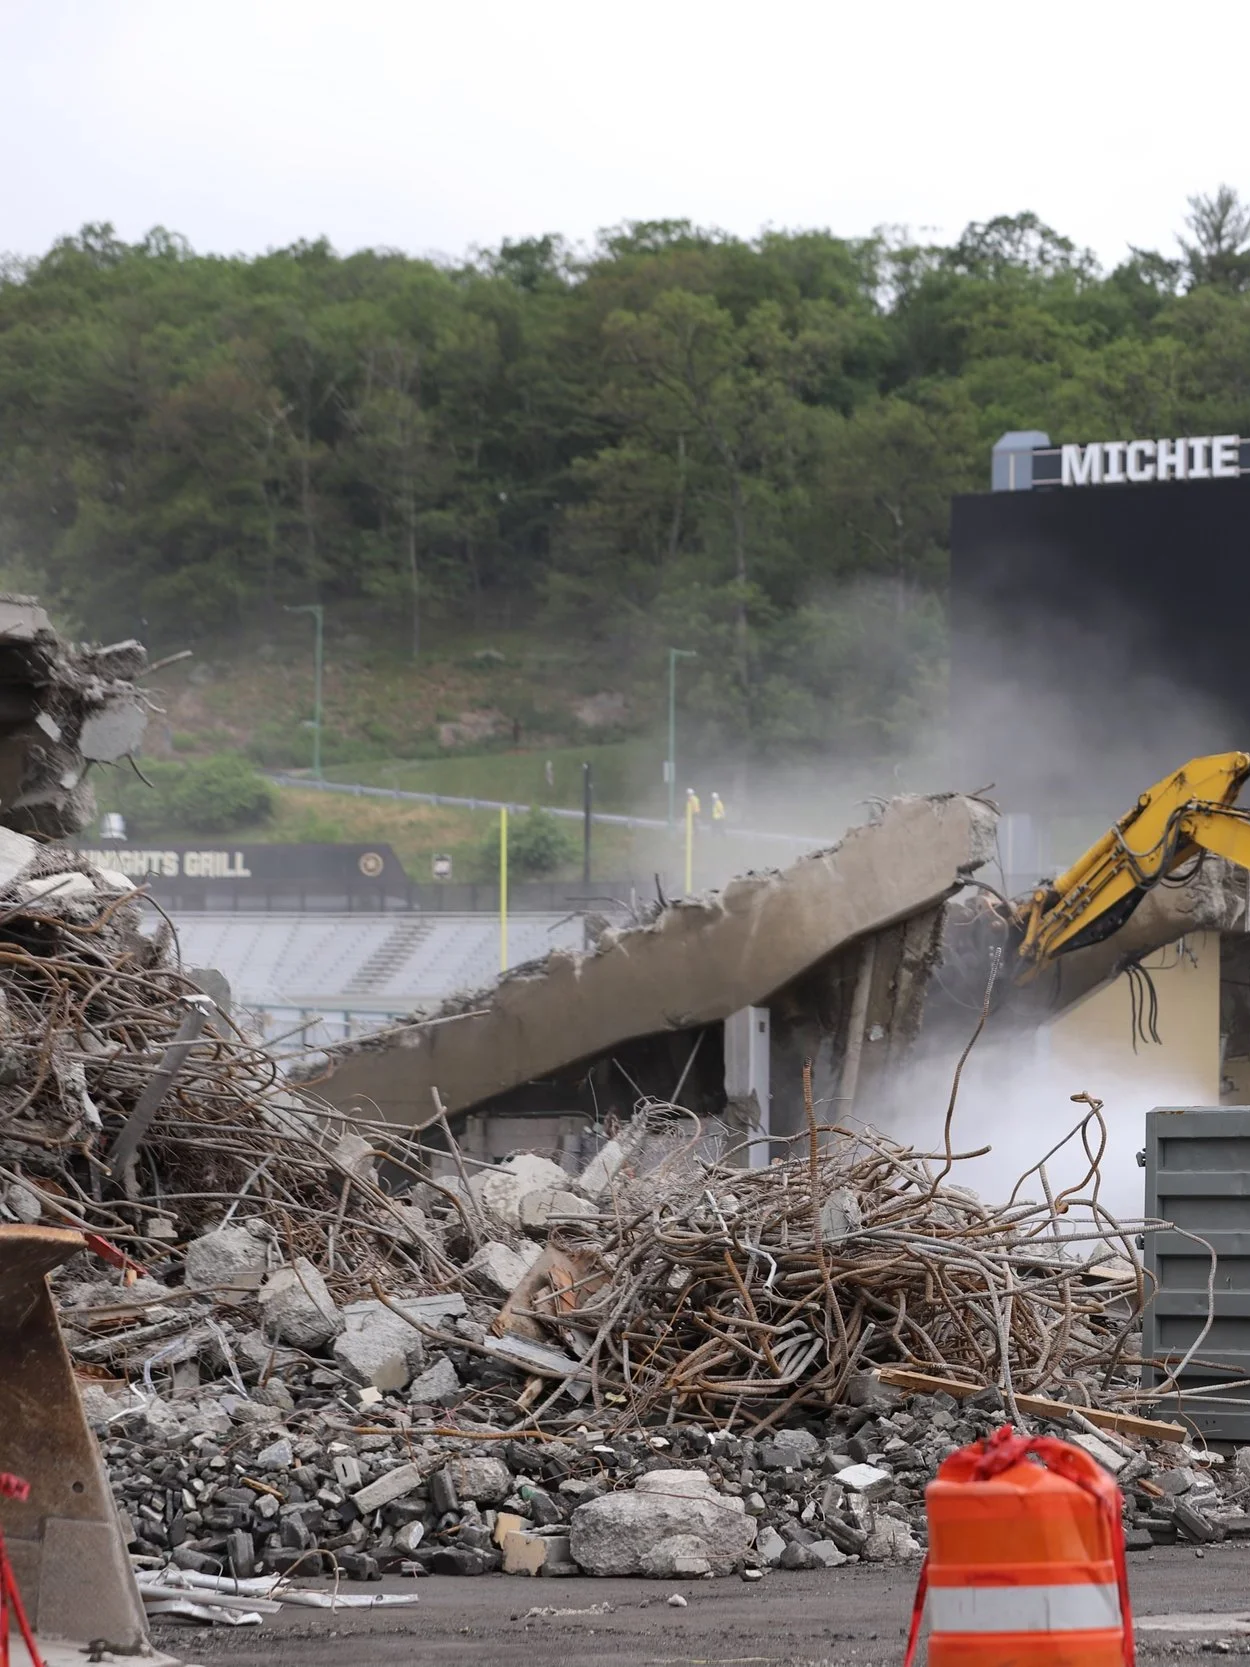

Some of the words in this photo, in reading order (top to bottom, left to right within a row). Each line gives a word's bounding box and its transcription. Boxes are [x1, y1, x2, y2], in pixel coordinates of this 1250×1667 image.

[1059, 434, 1241, 487] MICHIE
[78, 849, 179, 877] NIGHTS
[183, 851, 251, 877] GRILL
